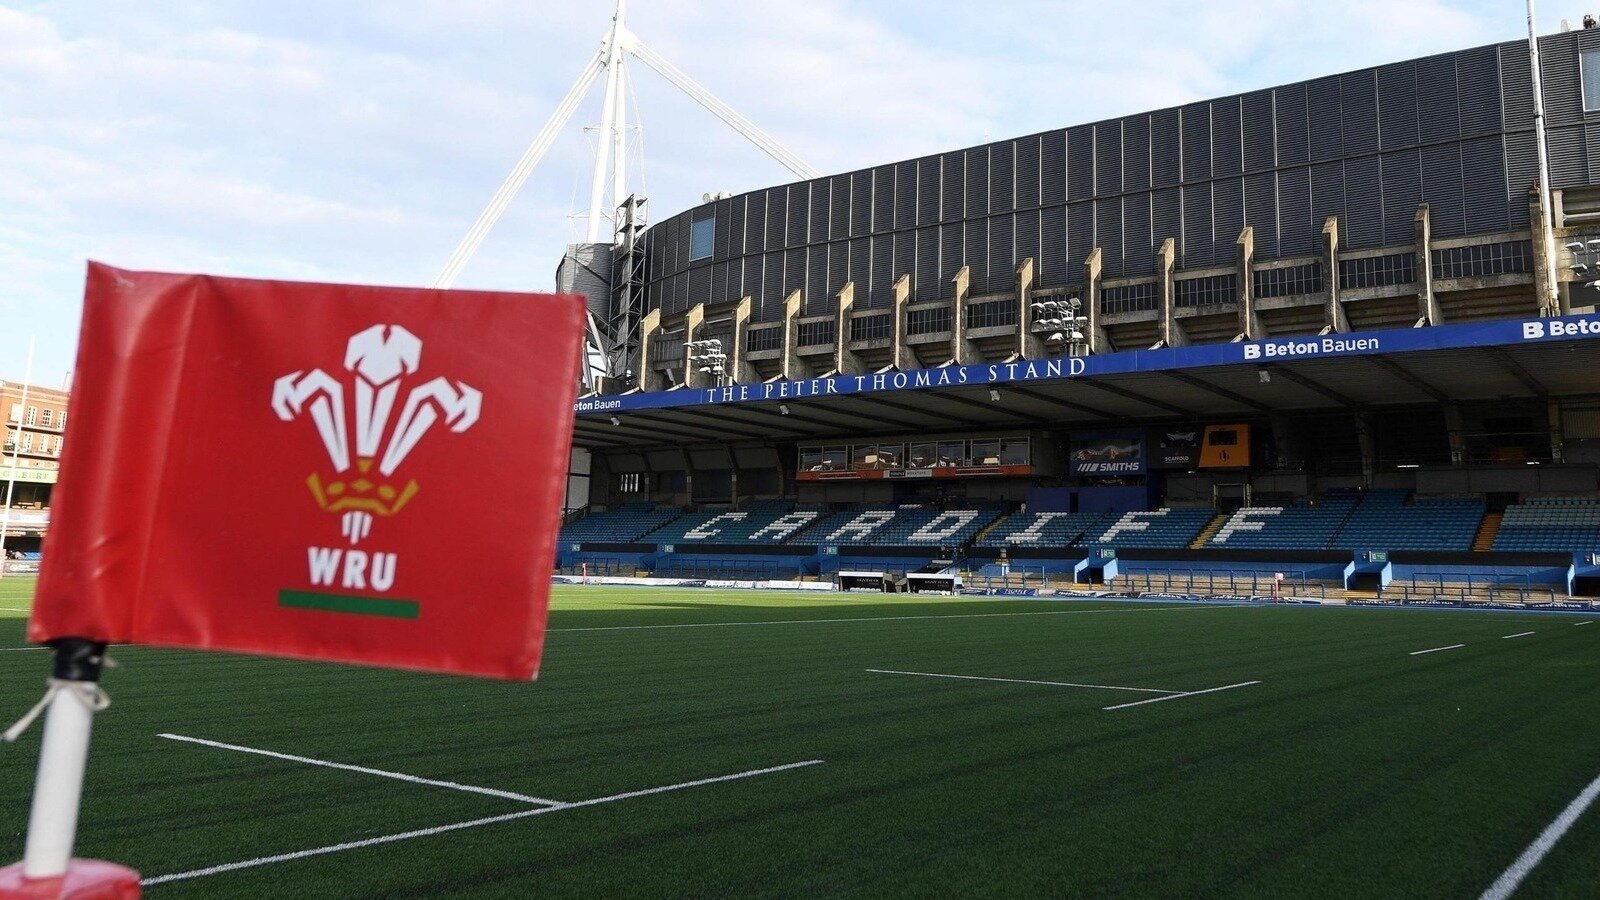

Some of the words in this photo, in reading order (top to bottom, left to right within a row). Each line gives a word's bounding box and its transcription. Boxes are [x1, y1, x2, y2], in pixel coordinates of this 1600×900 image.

[1549, 319, 1600, 336] Beto
[1265, 342, 1318, 357] Beton
[1322, 338, 1379, 353] Bauen
[706, 386, 748, 403] THE
[764, 378, 838, 399] PETER
[854, 366, 967, 392] THOMAS
[988, 358, 1088, 381] STAND
[573, 401, 593, 411] eton
[594, 400, 621, 410] Bauen
[1100, 462, 1139, 472] SMITHS
[683, 506, 1284, 543] CARDIFF
[307, 546, 398, 592] WRU
